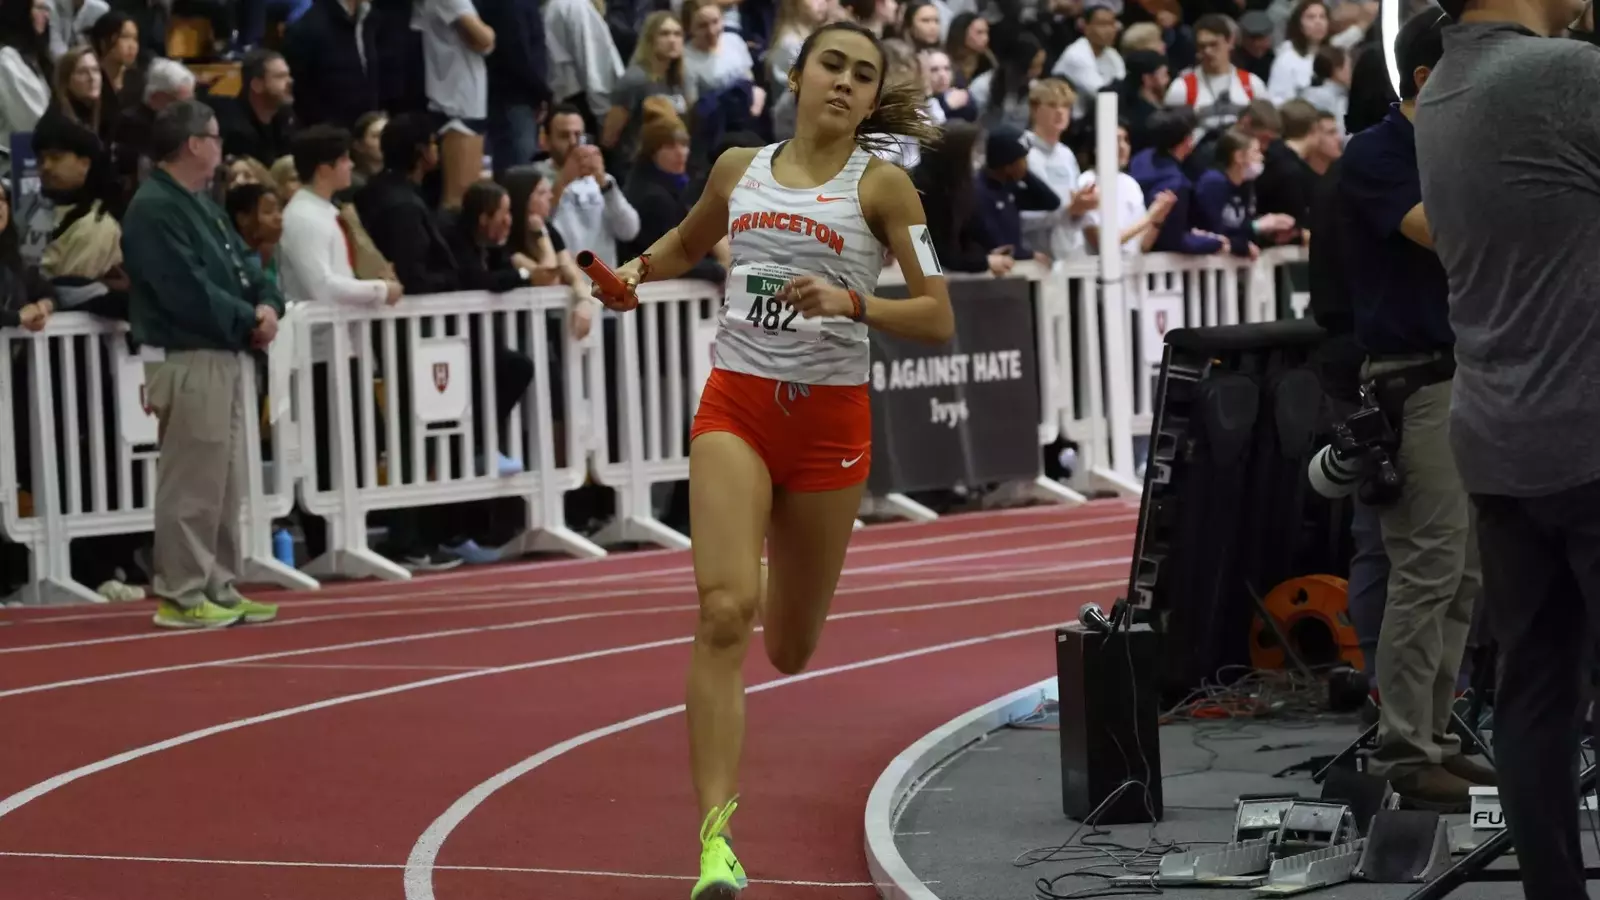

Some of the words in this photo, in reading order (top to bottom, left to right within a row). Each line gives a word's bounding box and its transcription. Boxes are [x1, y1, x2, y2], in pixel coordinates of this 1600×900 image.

[731, 211, 844, 256] PRINCETON
[919, 227, 941, 273] 1
[746, 295, 798, 333] 482
[889, 353, 970, 390] AGAINST
[973, 349, 1023, 383] HATE
